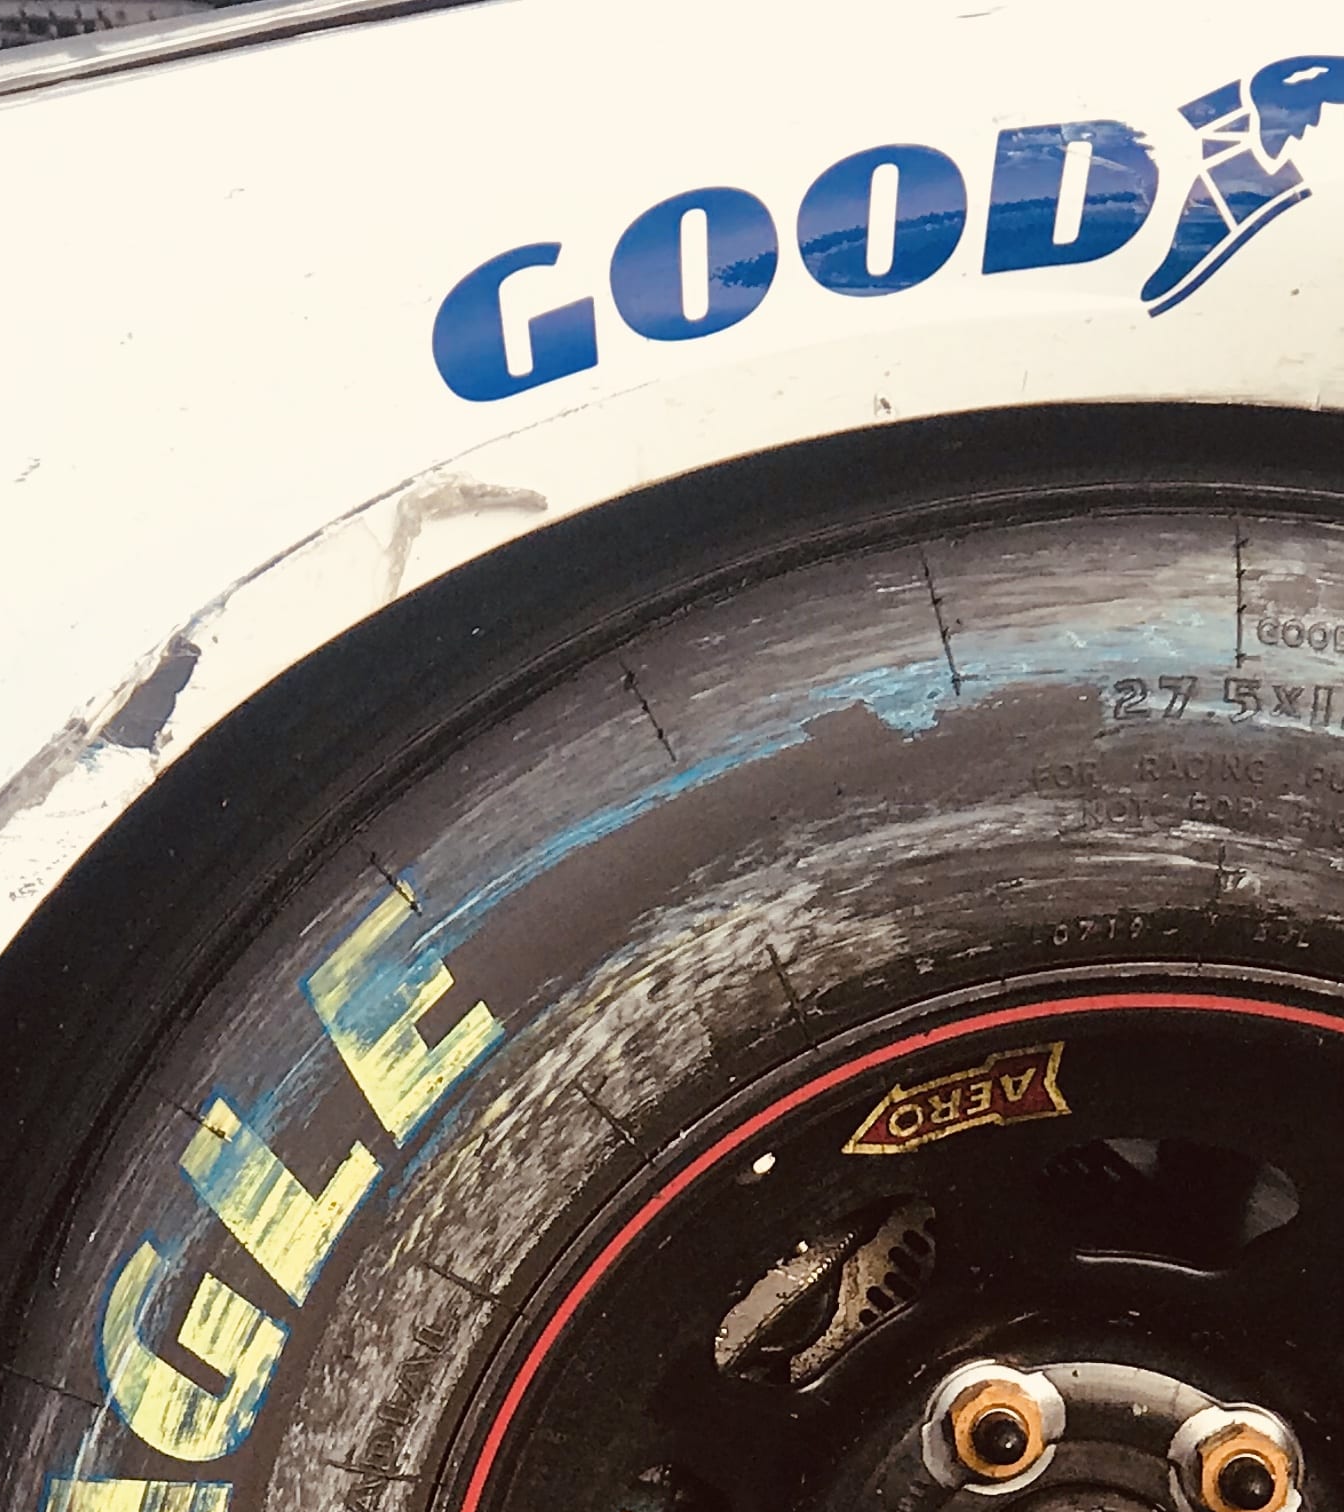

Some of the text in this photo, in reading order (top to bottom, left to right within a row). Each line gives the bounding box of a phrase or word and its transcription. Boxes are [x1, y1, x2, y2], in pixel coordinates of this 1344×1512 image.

[1033, 760, 1098, 790] FOR
[1140, 754, 1265, 786] RACING
[888, 1067, 1037, 1138] AERO
